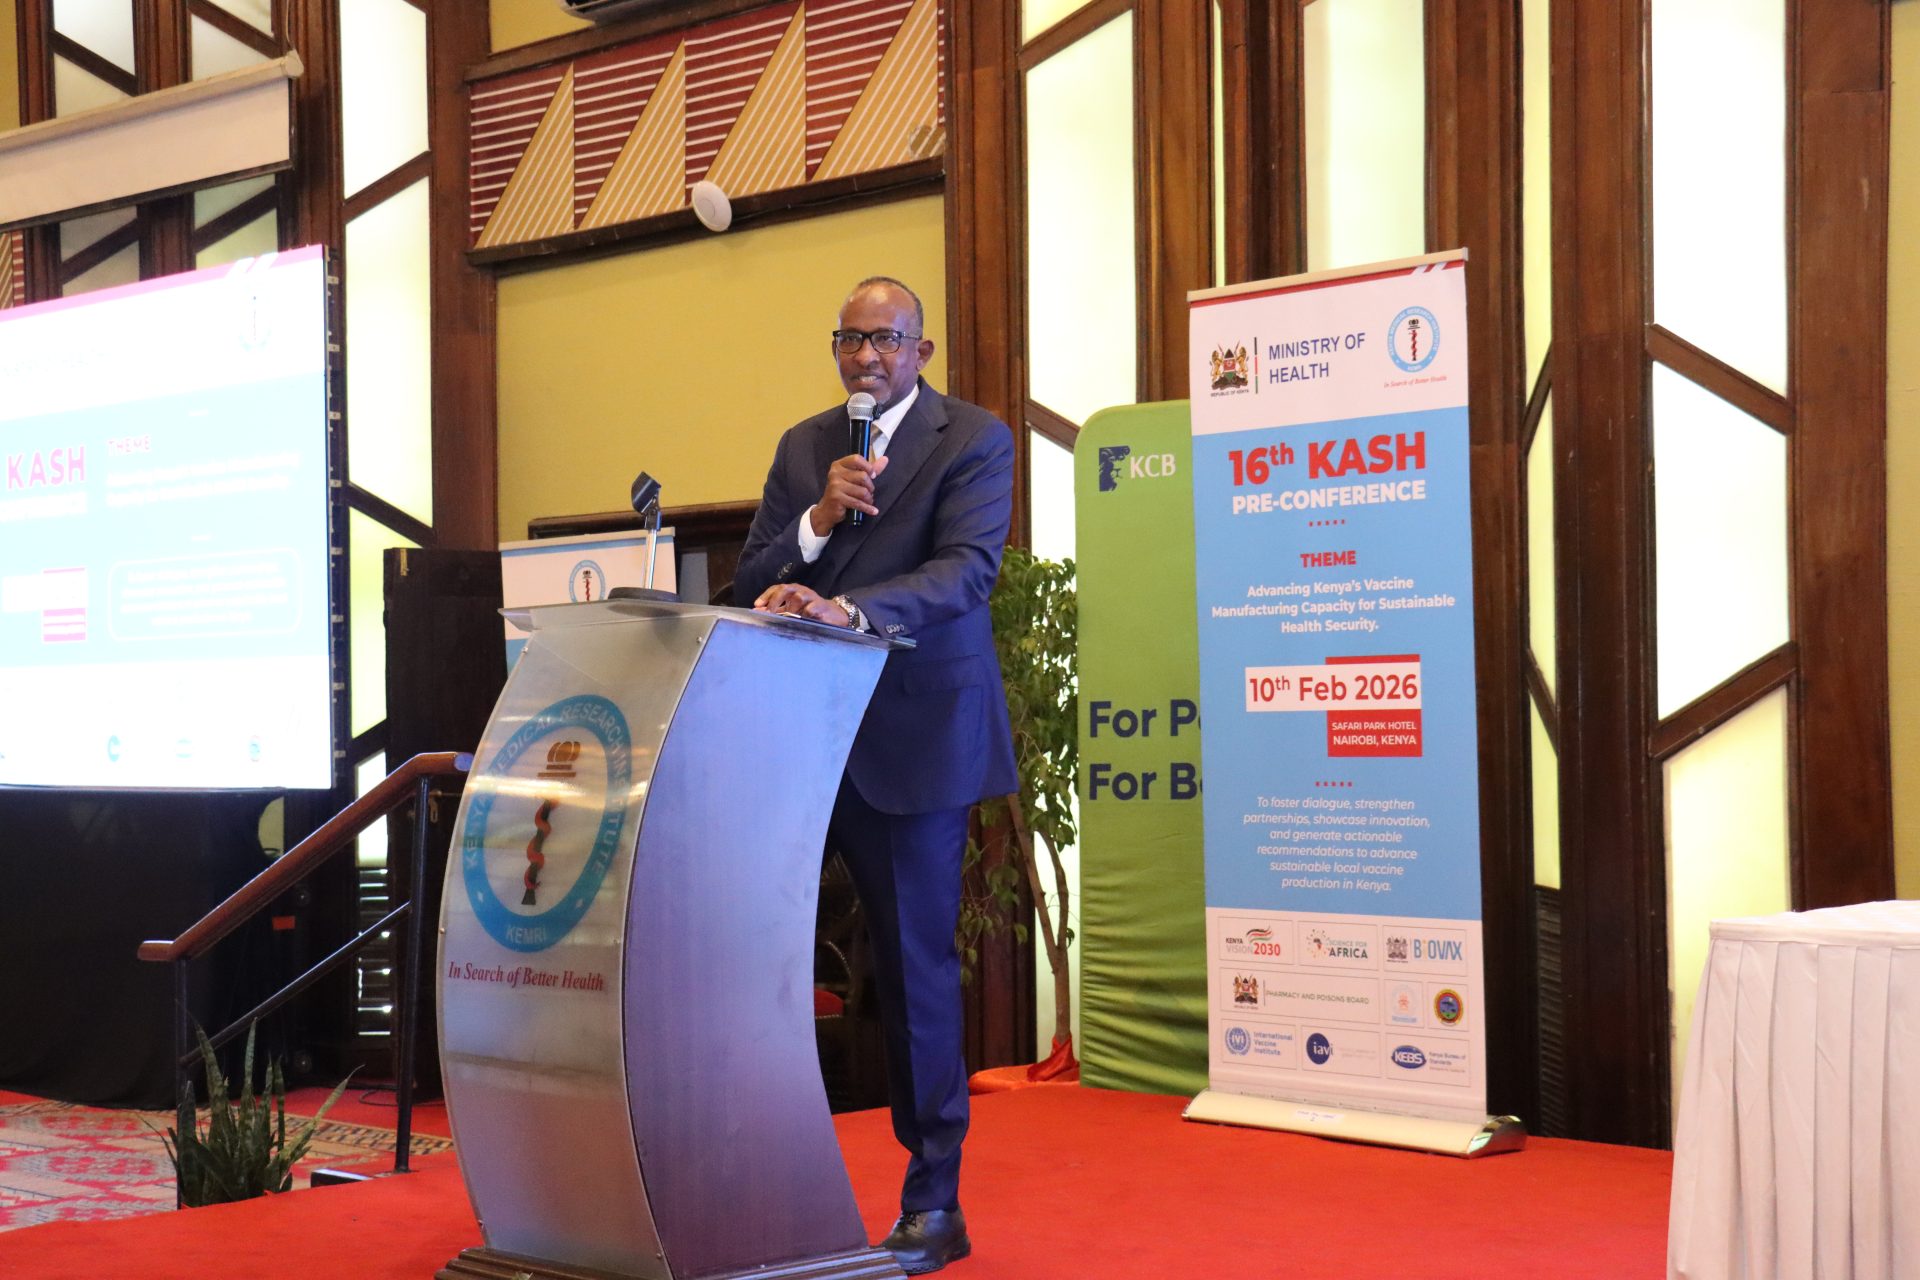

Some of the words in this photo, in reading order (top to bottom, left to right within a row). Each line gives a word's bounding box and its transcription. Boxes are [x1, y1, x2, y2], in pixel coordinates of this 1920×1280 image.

[1269, 336, 1341, 360] MINISTRY
[1345, 333, 1366, 350] OF
[1269, 362, 1329, 384] HEALTH
[1130, 453, 1177, 479] KCB
[1228, 442, 1294, 486] 16th
[1308, 431, 1426, 479] KASH
[6, 445, 86, 490] KASH
[1232, 479, 1426, 514] PRE-CONFERENCE
[1300, 550, 1357, 568] THEME
[1247, 582, 1311, 598] Advancing
[1313, 579, 1361, 595] Kenya's
[1363, 576, 1414, 591] Vaccine
[1212, 600, 1298, 618] Manufacturing
[1301, 599, 1355, 615] Capacity
[1358, 597, 1376, 611] for
[1378, 594, 1455, 610] Sustainable
[1281, 618, 1321, 634] Health
[1325, 616, 1379, 632] Security.
[1250, 675, 1291, 702] 10th
[1299, 674, 1347, 702] Feb
[1354, 673, 1418, 700] 2026
[1089, 701, 1157, 738] For
[1170, 698, 1201, 737] P
[1331, 722, 1362, 731] SAFARI
[1363, 721, 1386, 730] PARK
[1388, 721, 1417, 730] HOTEL
[489, 716, 553, 778] EDICA
[560, 702, 624, 753] RESEARCH
[1333, 735, 1379, 747] NAIROBI,
[1381, 734, 1417, 745] KENYA
[1089, 763, 1157, 800] For
[1170, 762, 1203, 800] B
[1257, 796, 1269, 807] To
[1271, 797, 1300, 808] foster
[1302, 797, 1353, 811] dialogue,
[1354, 798, 1415, 812] strengthen
[1243, 813, 1311, 825] partnerships,
[1313, 814, 1367, 825] showcase
[1369, 816, 1430, 829] innovation,
[1270, 829, 1290, 840] and
[1292, 831, 1342, 842] generate
[1344, 831, 1403, 843] actionable
[1257, 845, 1354, 858] recommendations
[1356, 847, 1367, 858] to
[1369, 848, 1418, 859] advance
[1269, 860, 1331, 873] sustainable
[1333, 862, 1360, 874] local
[1362, 863, 1404, 875] vaccine
[1281, 877, 1340, 889] production
[1342, 878, 1353, 889] in
[1356, 879, 1392, 893] Kenya.
[506, 925, 547, 945] KEMRI
[1254, 942, 1281, 956] 2030
[1329, 947, 1368, 958] AFRICA
[448, 961, 461, 979] In
[463, 962, 503, 982] Search
[506, 966, 522, 988] of
[522, 967, 558, 987] Better
[562, 970, 603, 991] Health
[1266, 990, 1300, 998] PHARMACY
[1316, 994, 1344, 1003] POISONS
[1346, 996, 1369, 1004] BOARD
[1253, 1031, 1293, 1041] International
[1254, 1039, 1276, 1047] Vaccine
[1255, 1047, 1280, 1055] Institute
[1313, 1041, 1333, 1056] iavi
[1394, 1051, 1423, 1064] KEBS
